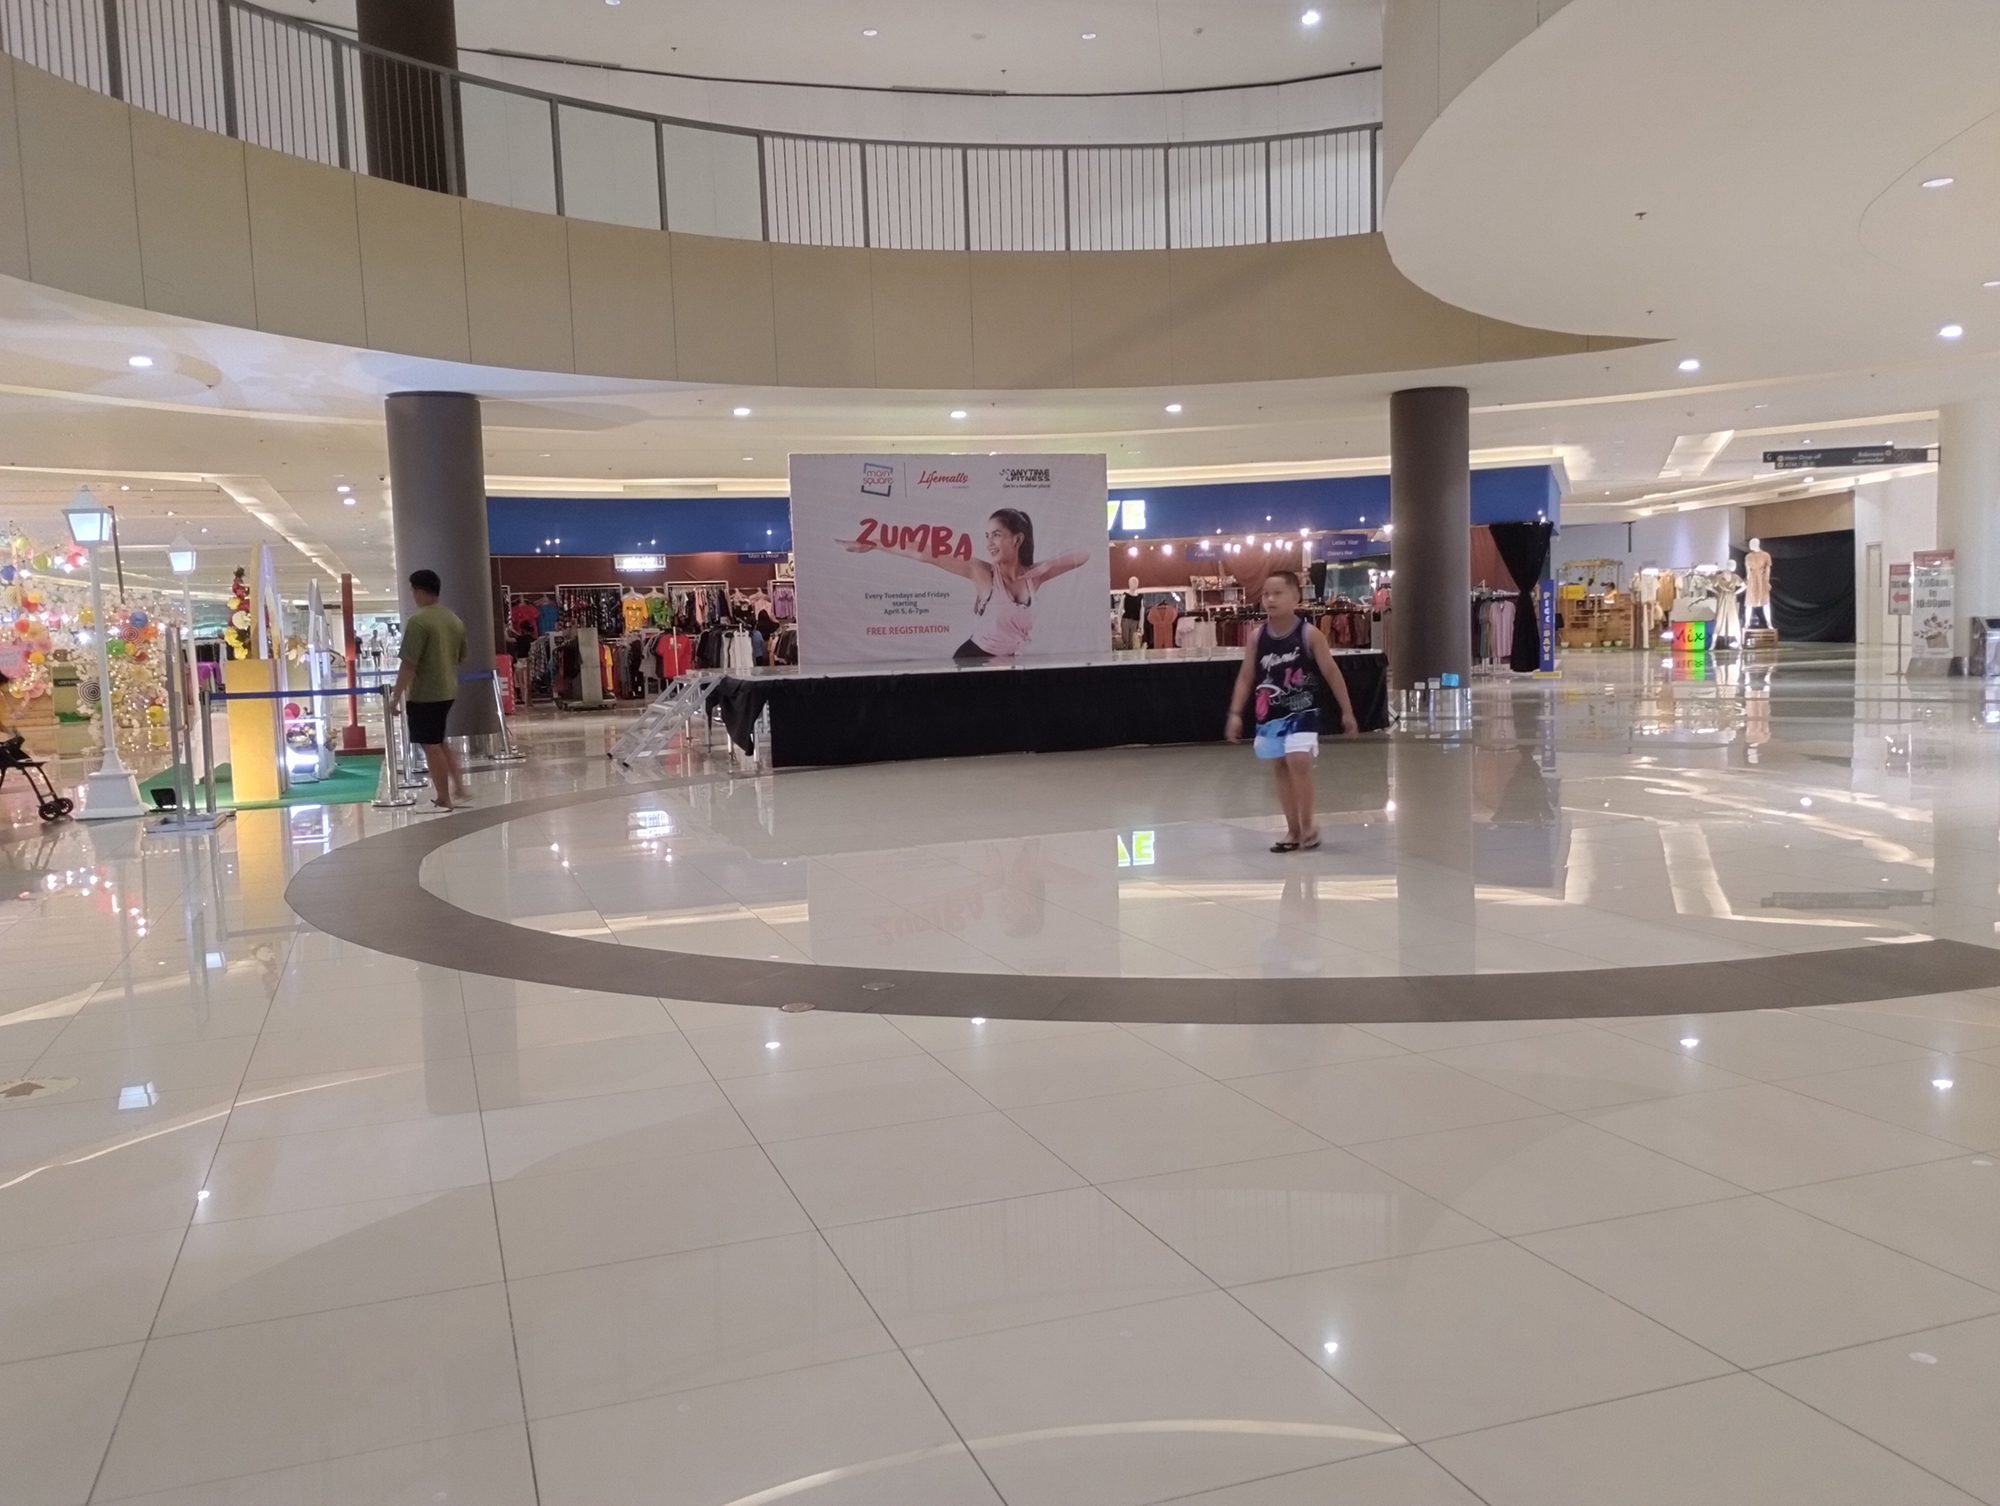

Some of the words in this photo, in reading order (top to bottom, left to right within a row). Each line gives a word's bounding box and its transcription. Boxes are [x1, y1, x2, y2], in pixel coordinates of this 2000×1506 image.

[1010, 468, 1050, 476] ANYTIME
[863, 477, 894, 486] square
[917, 470, 969, 489] Lifemalls
[856, 518, 973, 561] ZUMBA
[884, 592, 913, 600] Tuesdays
[927, 591, 950, 599] Fridays
[884, 608, 900, 616] April
[866, 627, 887, 635] FREE
[889, 625, 950, 635] REGISTRATION
[1283, 667, 1304, 688] 14
